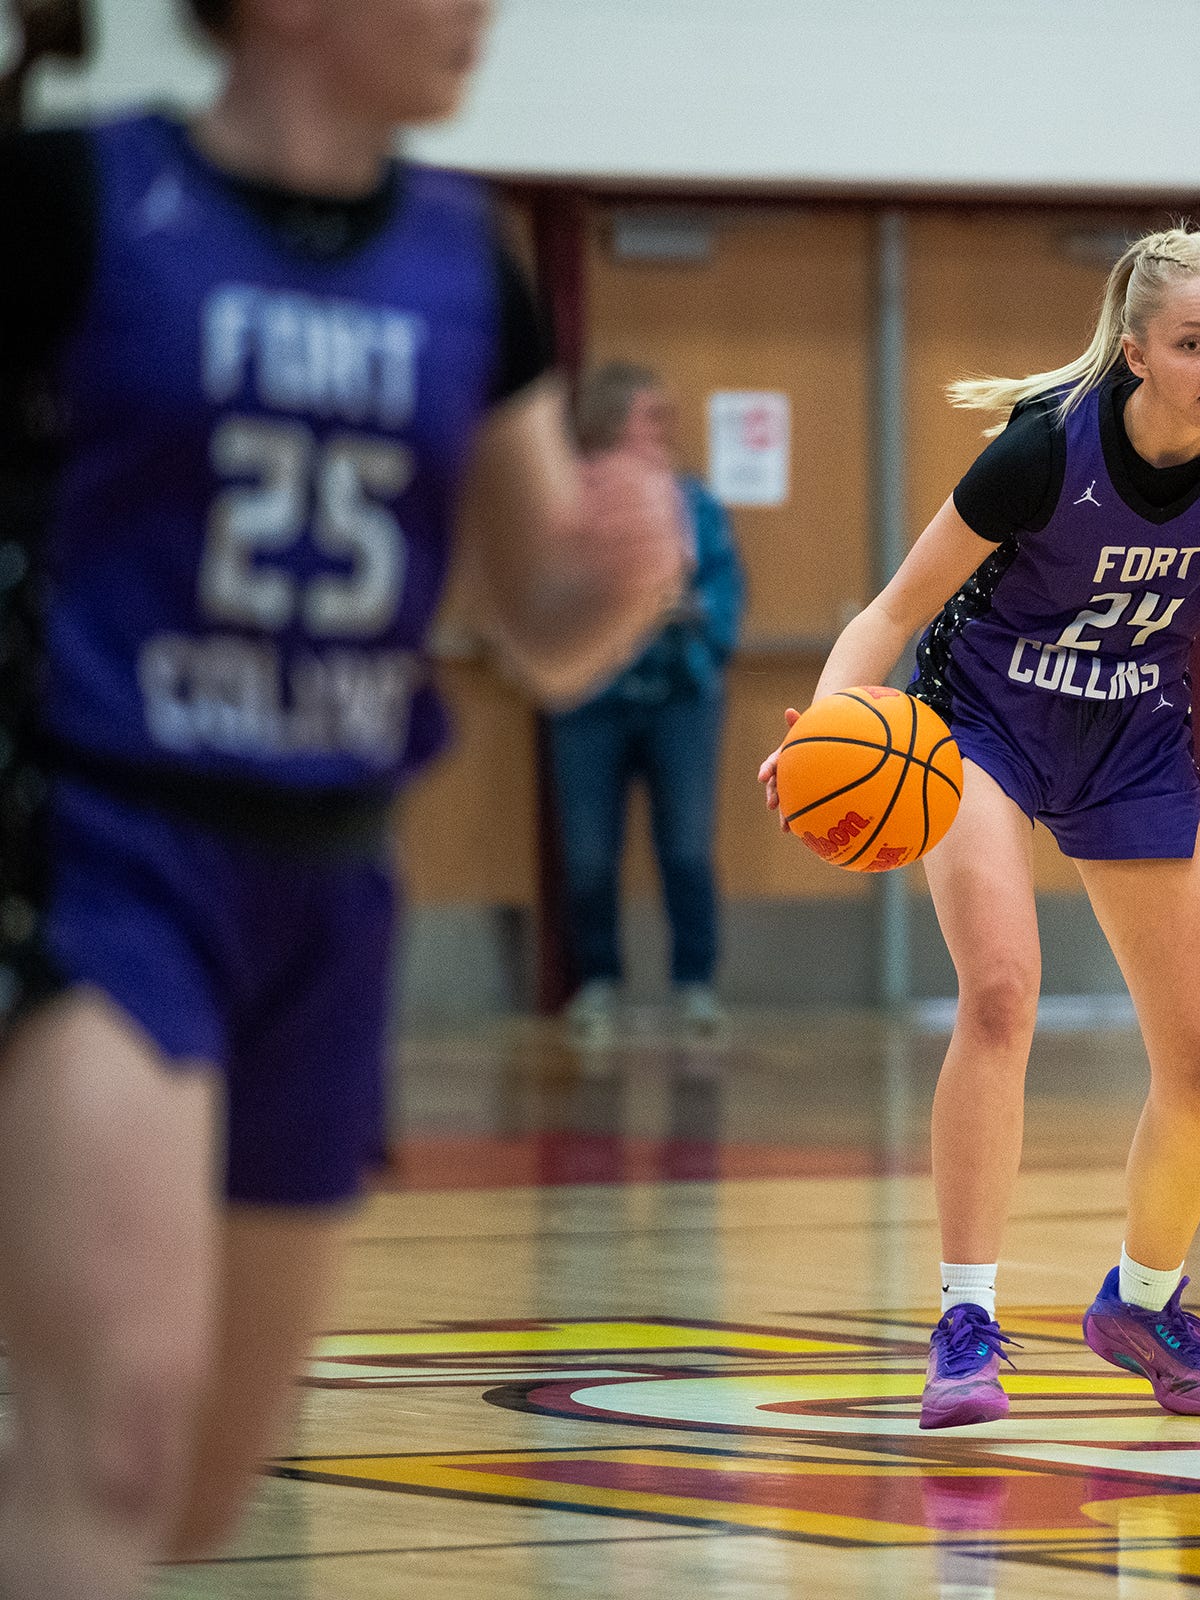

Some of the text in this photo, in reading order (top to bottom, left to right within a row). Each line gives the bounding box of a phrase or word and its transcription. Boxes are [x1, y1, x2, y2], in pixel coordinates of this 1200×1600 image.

[203, 285, 422, 424] FORT
[203, 415, 412, 634] 25
[1008, 637, 1160, 700] COLLINS
[1056, 591, 1185, 651] 24
